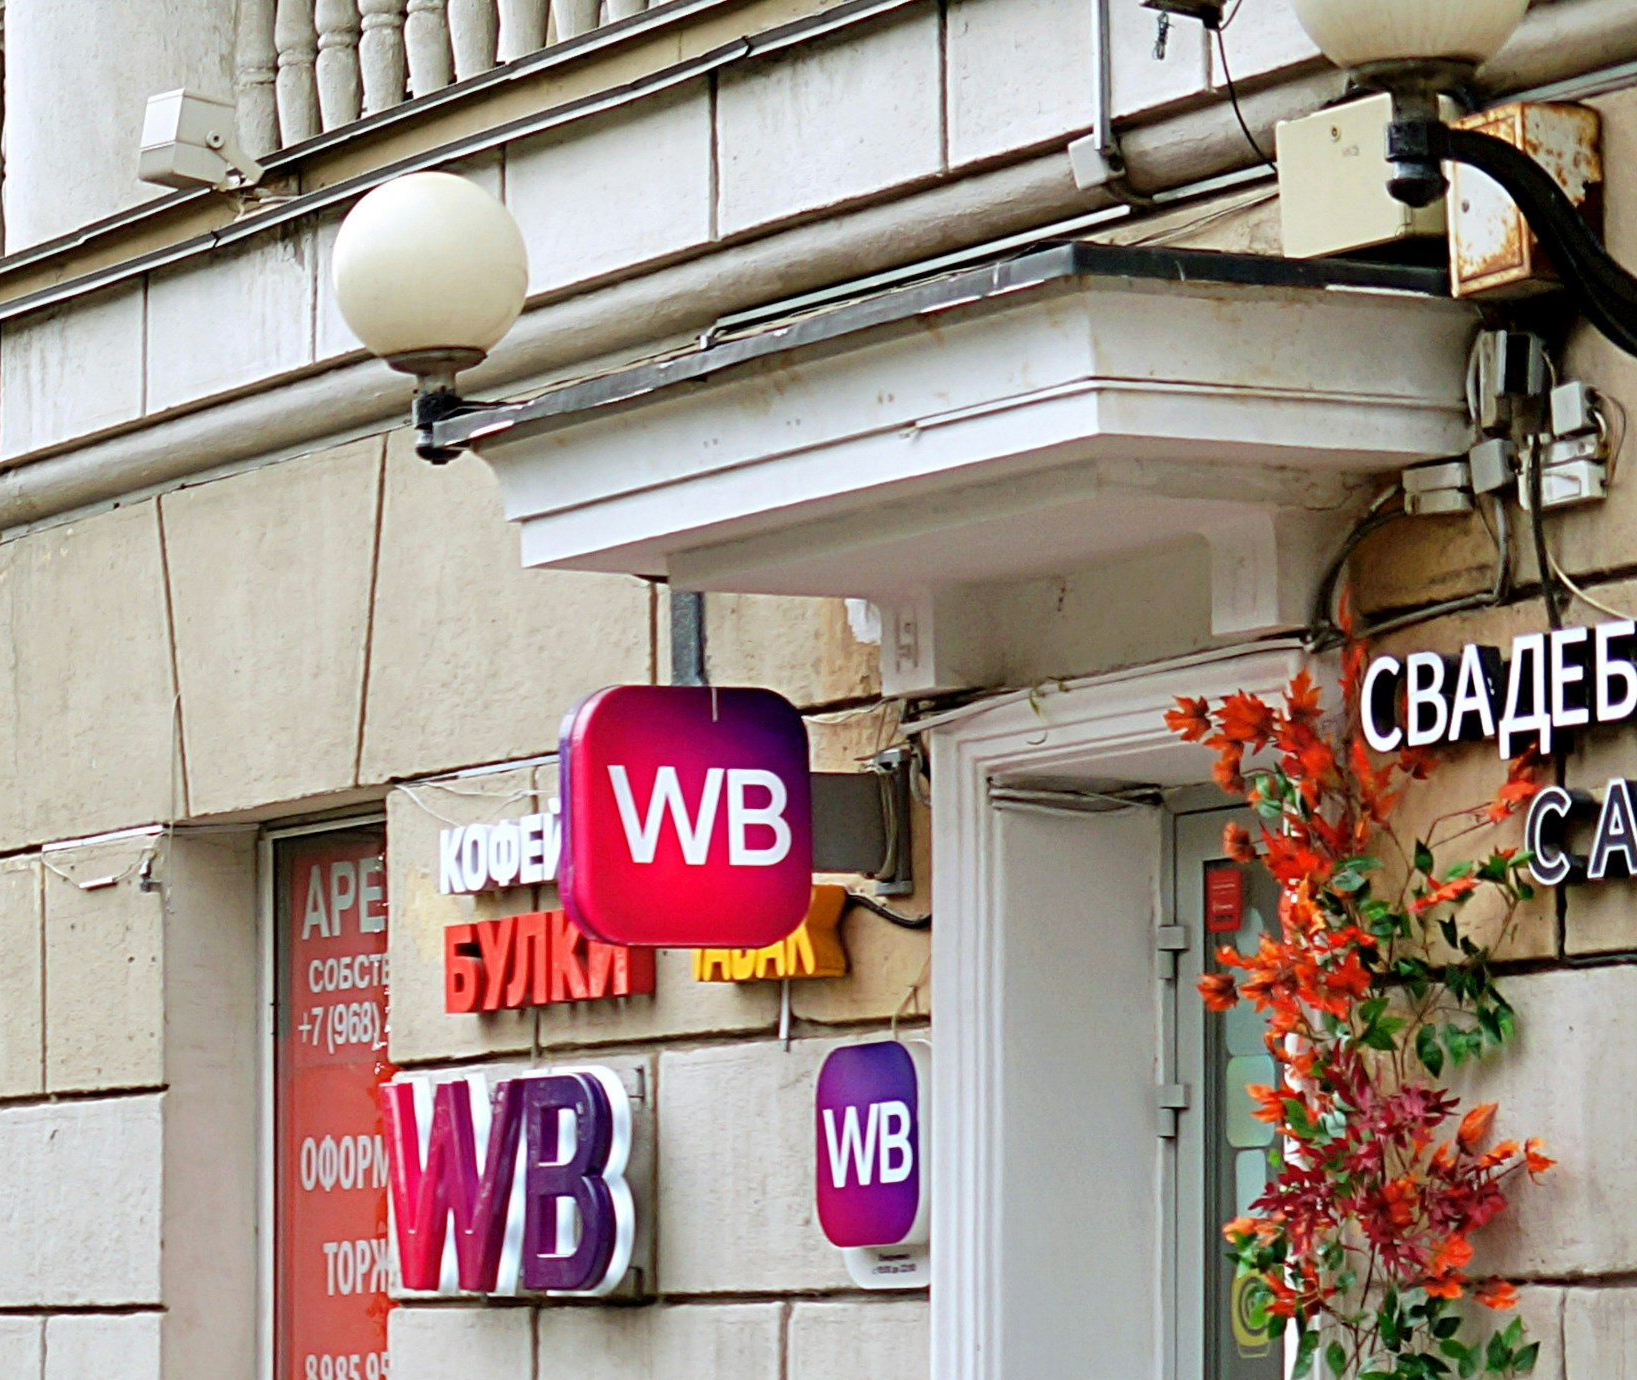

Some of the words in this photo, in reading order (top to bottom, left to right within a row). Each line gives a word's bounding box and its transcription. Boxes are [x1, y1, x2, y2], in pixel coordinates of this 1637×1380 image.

[1361, 620, 1637, 760] СВАДЕБ
[608, 765, 793, 866] WB
[381, 1068, 621, 1293] WB
[823, 1101, 914, 1188] WB
